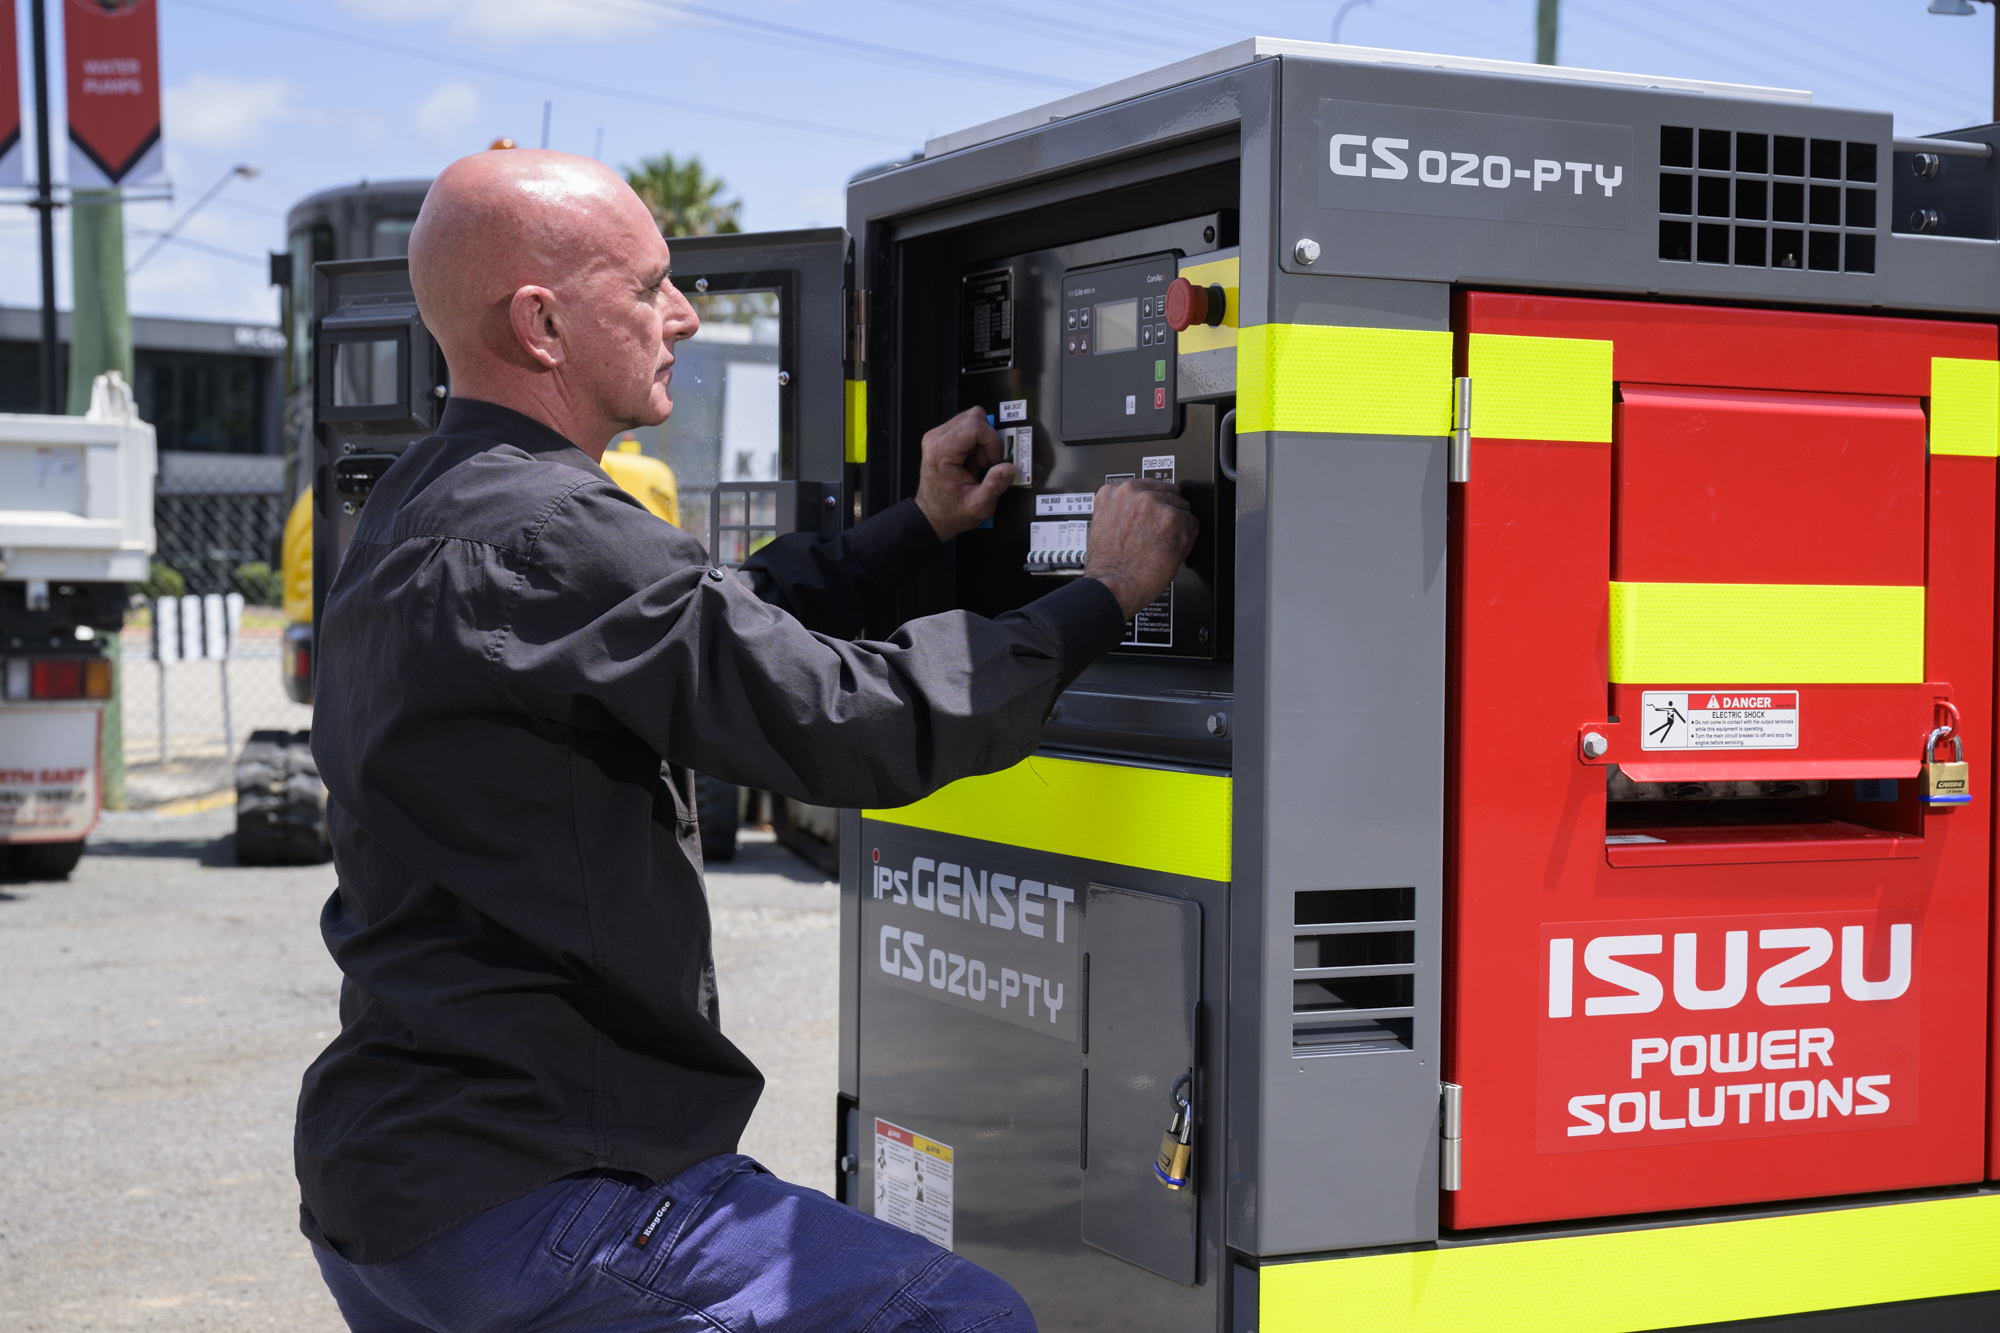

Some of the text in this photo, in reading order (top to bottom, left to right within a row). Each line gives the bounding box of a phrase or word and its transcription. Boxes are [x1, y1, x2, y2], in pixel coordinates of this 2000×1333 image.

[82, 58, 141, 76] WATER
[82, 77, 143, 95] PUMPS
[1329, 133, 1623, 197] GS 020-PTY
[1146, 273, 1163, 284] ComAp
[1144, 457, 1173, 469] POWER SWITCH
[1723, 697, 1771, 708] DANGER
[40, 767, 86, 785] EAST
[880, 924, 1064, 1024] GS 020-PTY
[1548, 923, 1912, 1018] ISUZU
[1631, 1027, 1835, 1079] POWER
[1567, 1074, 1891, 1137] SOLUTIONS
[642, 1201, 671, 1237] KingGee
